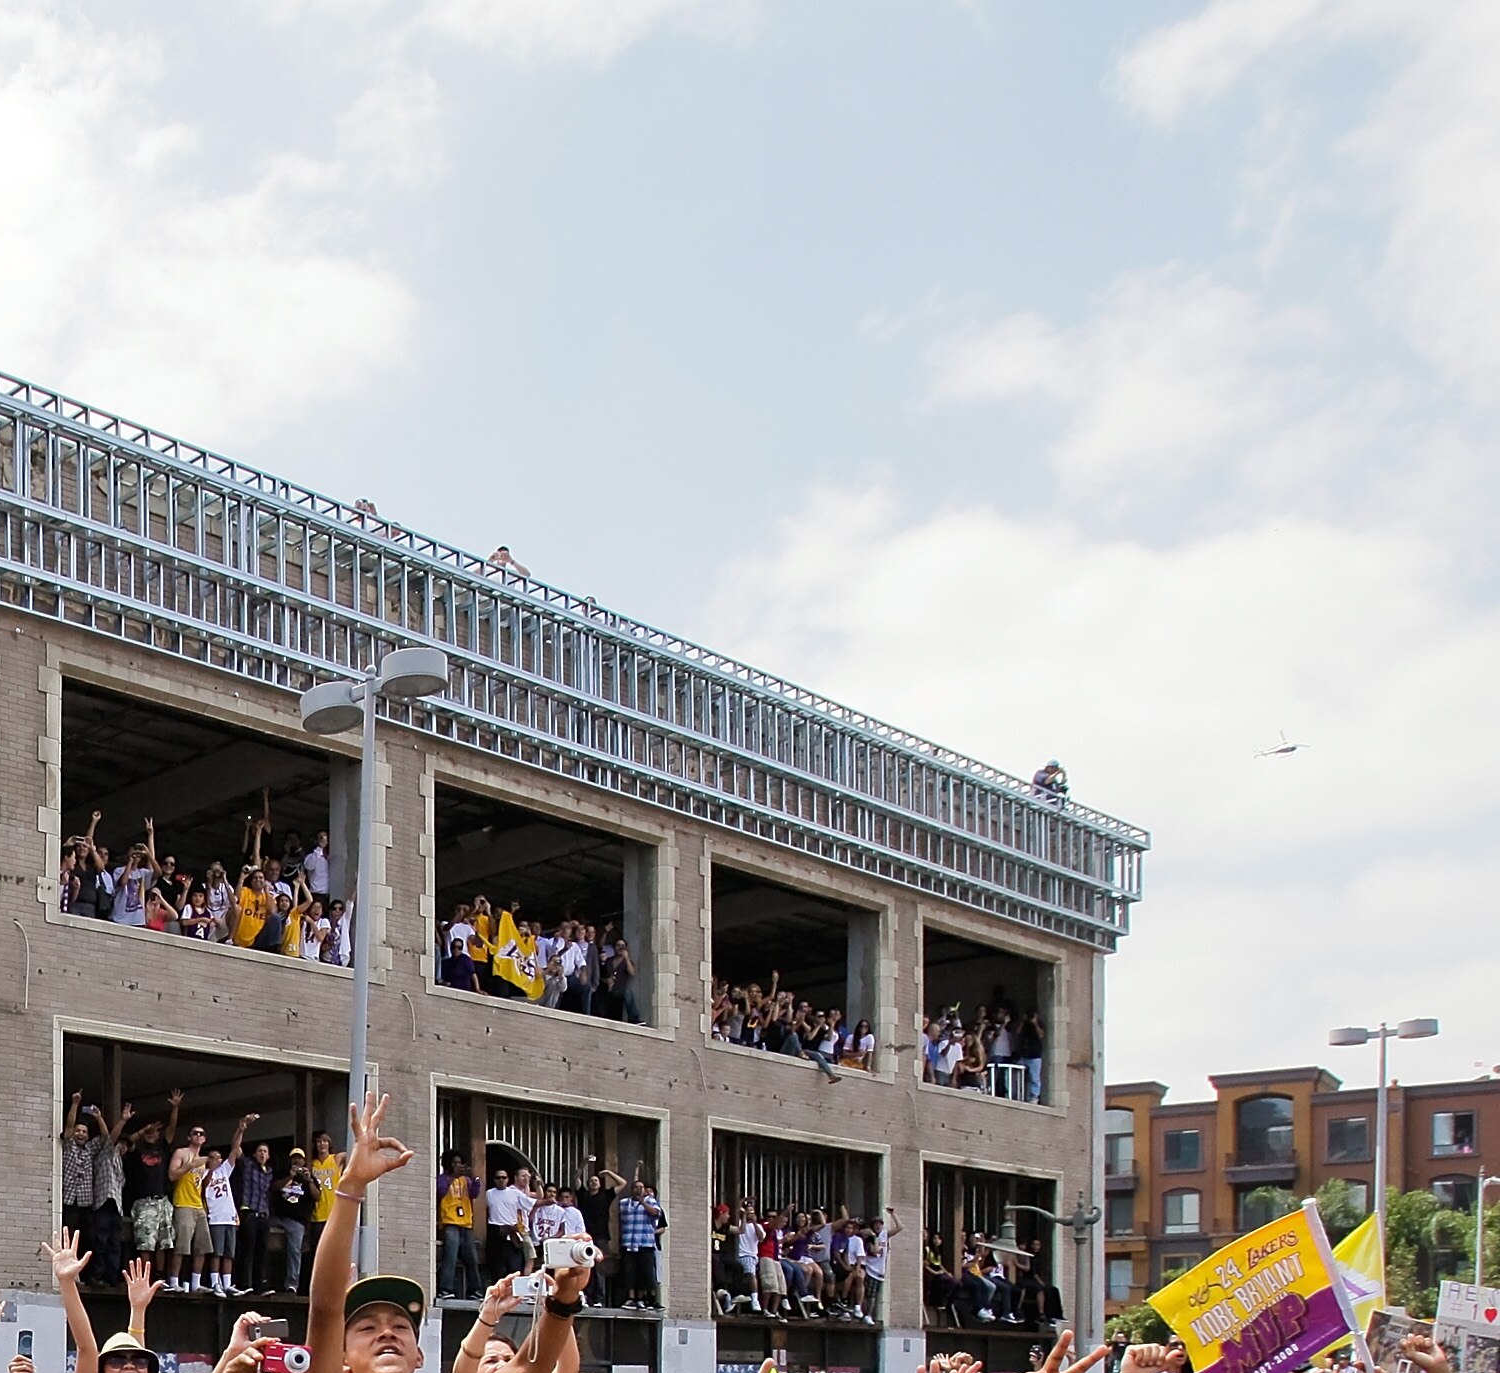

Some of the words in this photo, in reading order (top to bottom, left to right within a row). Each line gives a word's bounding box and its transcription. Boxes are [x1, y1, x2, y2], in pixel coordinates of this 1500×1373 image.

[213, 1184, 228, 1199] 24
[1215, 1257, 1244, 1290] 24
[1247, 1230, 1299, 1271] LAKERS
[1190, 1304, 1240, 1347] KOBE
[1234, 1252, 1304, 1312] BRYANT
